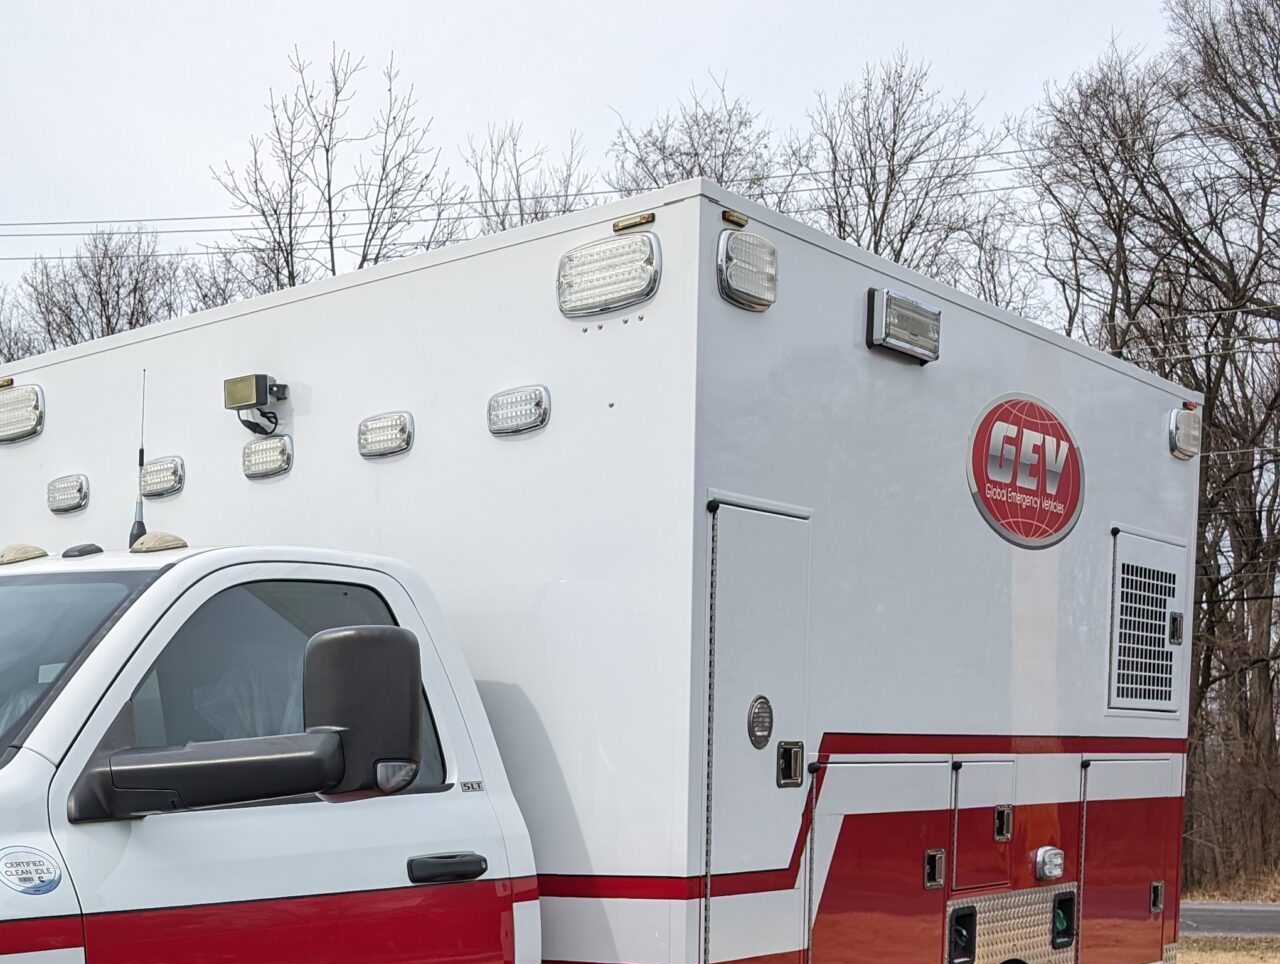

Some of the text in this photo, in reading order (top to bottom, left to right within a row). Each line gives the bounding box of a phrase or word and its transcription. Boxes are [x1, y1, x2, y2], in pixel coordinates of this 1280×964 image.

[987, 421, 1069, 496] GEV
[985, 483, 1065, 514] Global Emergency Vehicles
[463, 782, 481, 790] SLT
[4, 860, 45, 869] CERTIFIED
[4, 867, 53, 877] CLEAN IDLE
